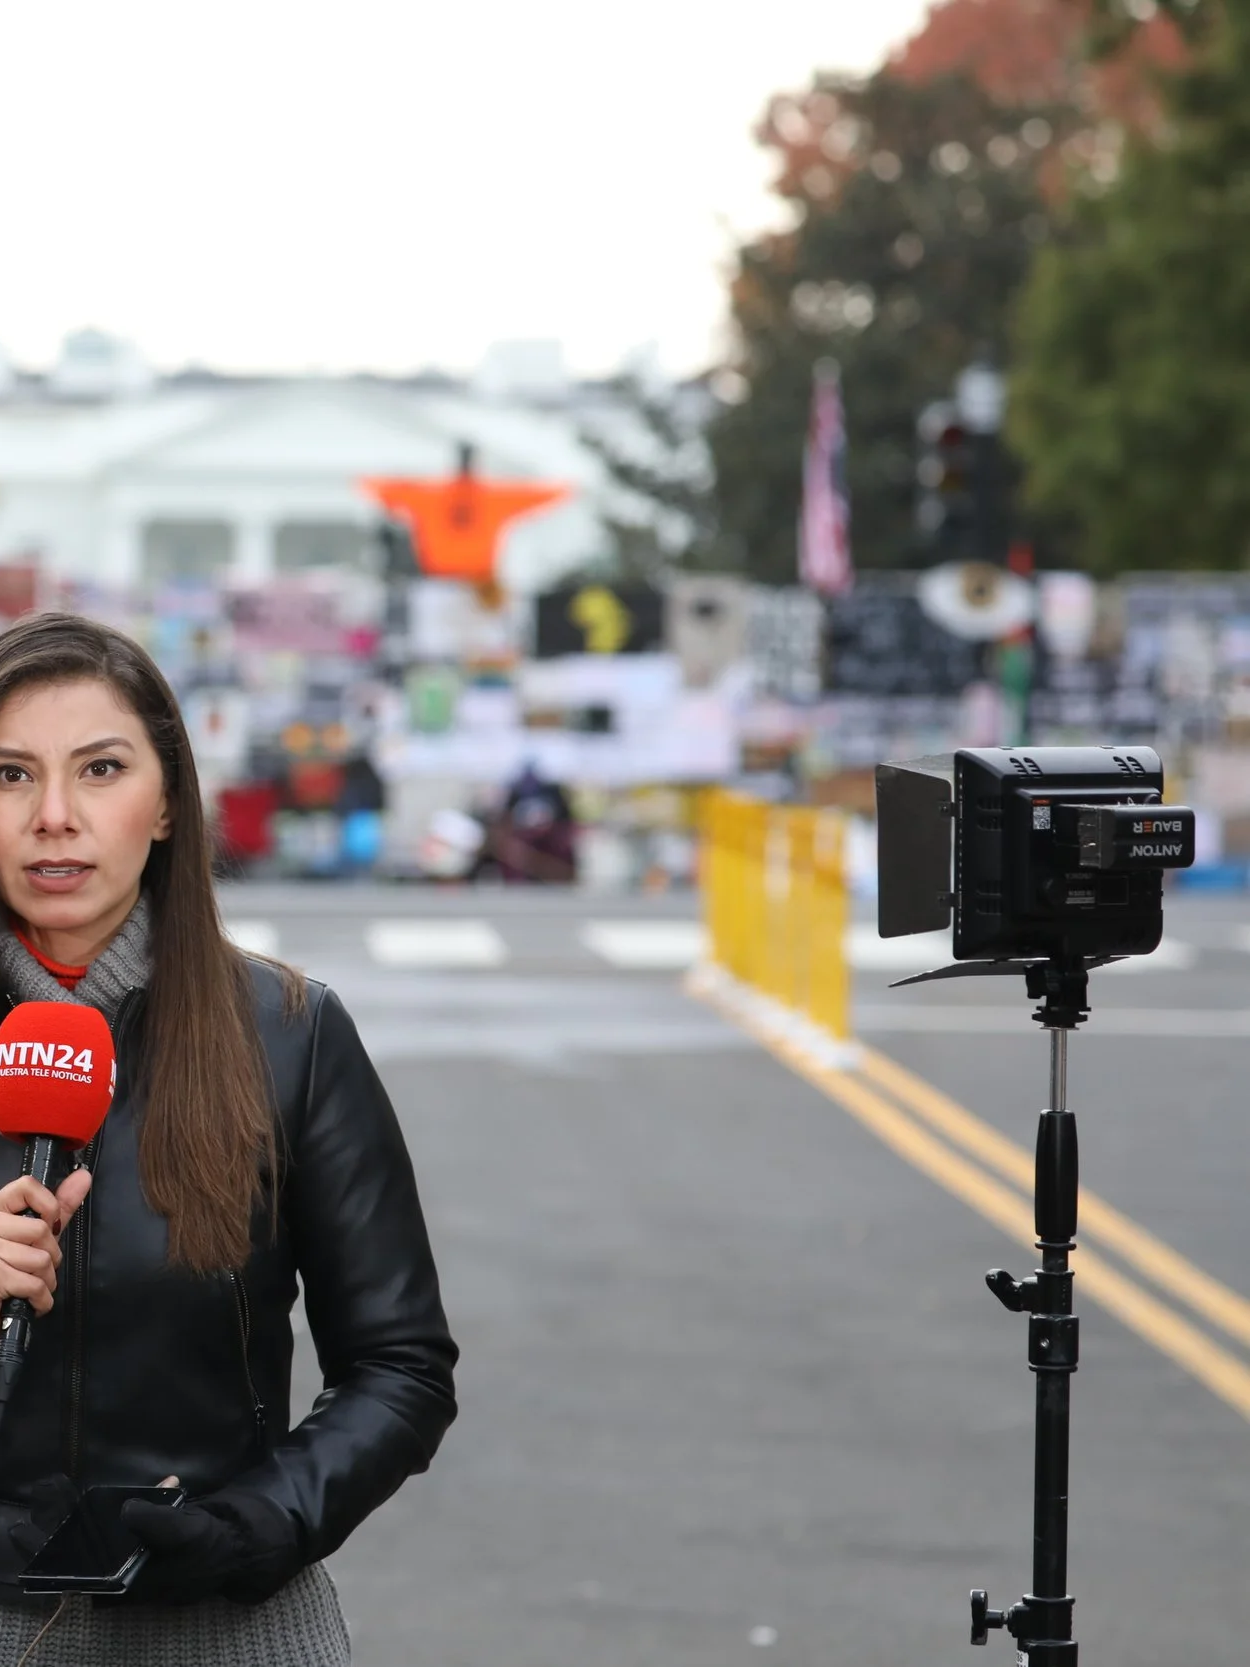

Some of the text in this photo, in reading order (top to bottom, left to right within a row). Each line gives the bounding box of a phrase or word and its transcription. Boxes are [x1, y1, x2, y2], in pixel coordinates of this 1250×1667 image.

[1133, 820, 1182, 833] BAUER
[1132, 844, 1182, 857] ANTON
[30, 1068, 50, 1077] TELE
[51, 1070, 92, 1084] NOTICIAS
